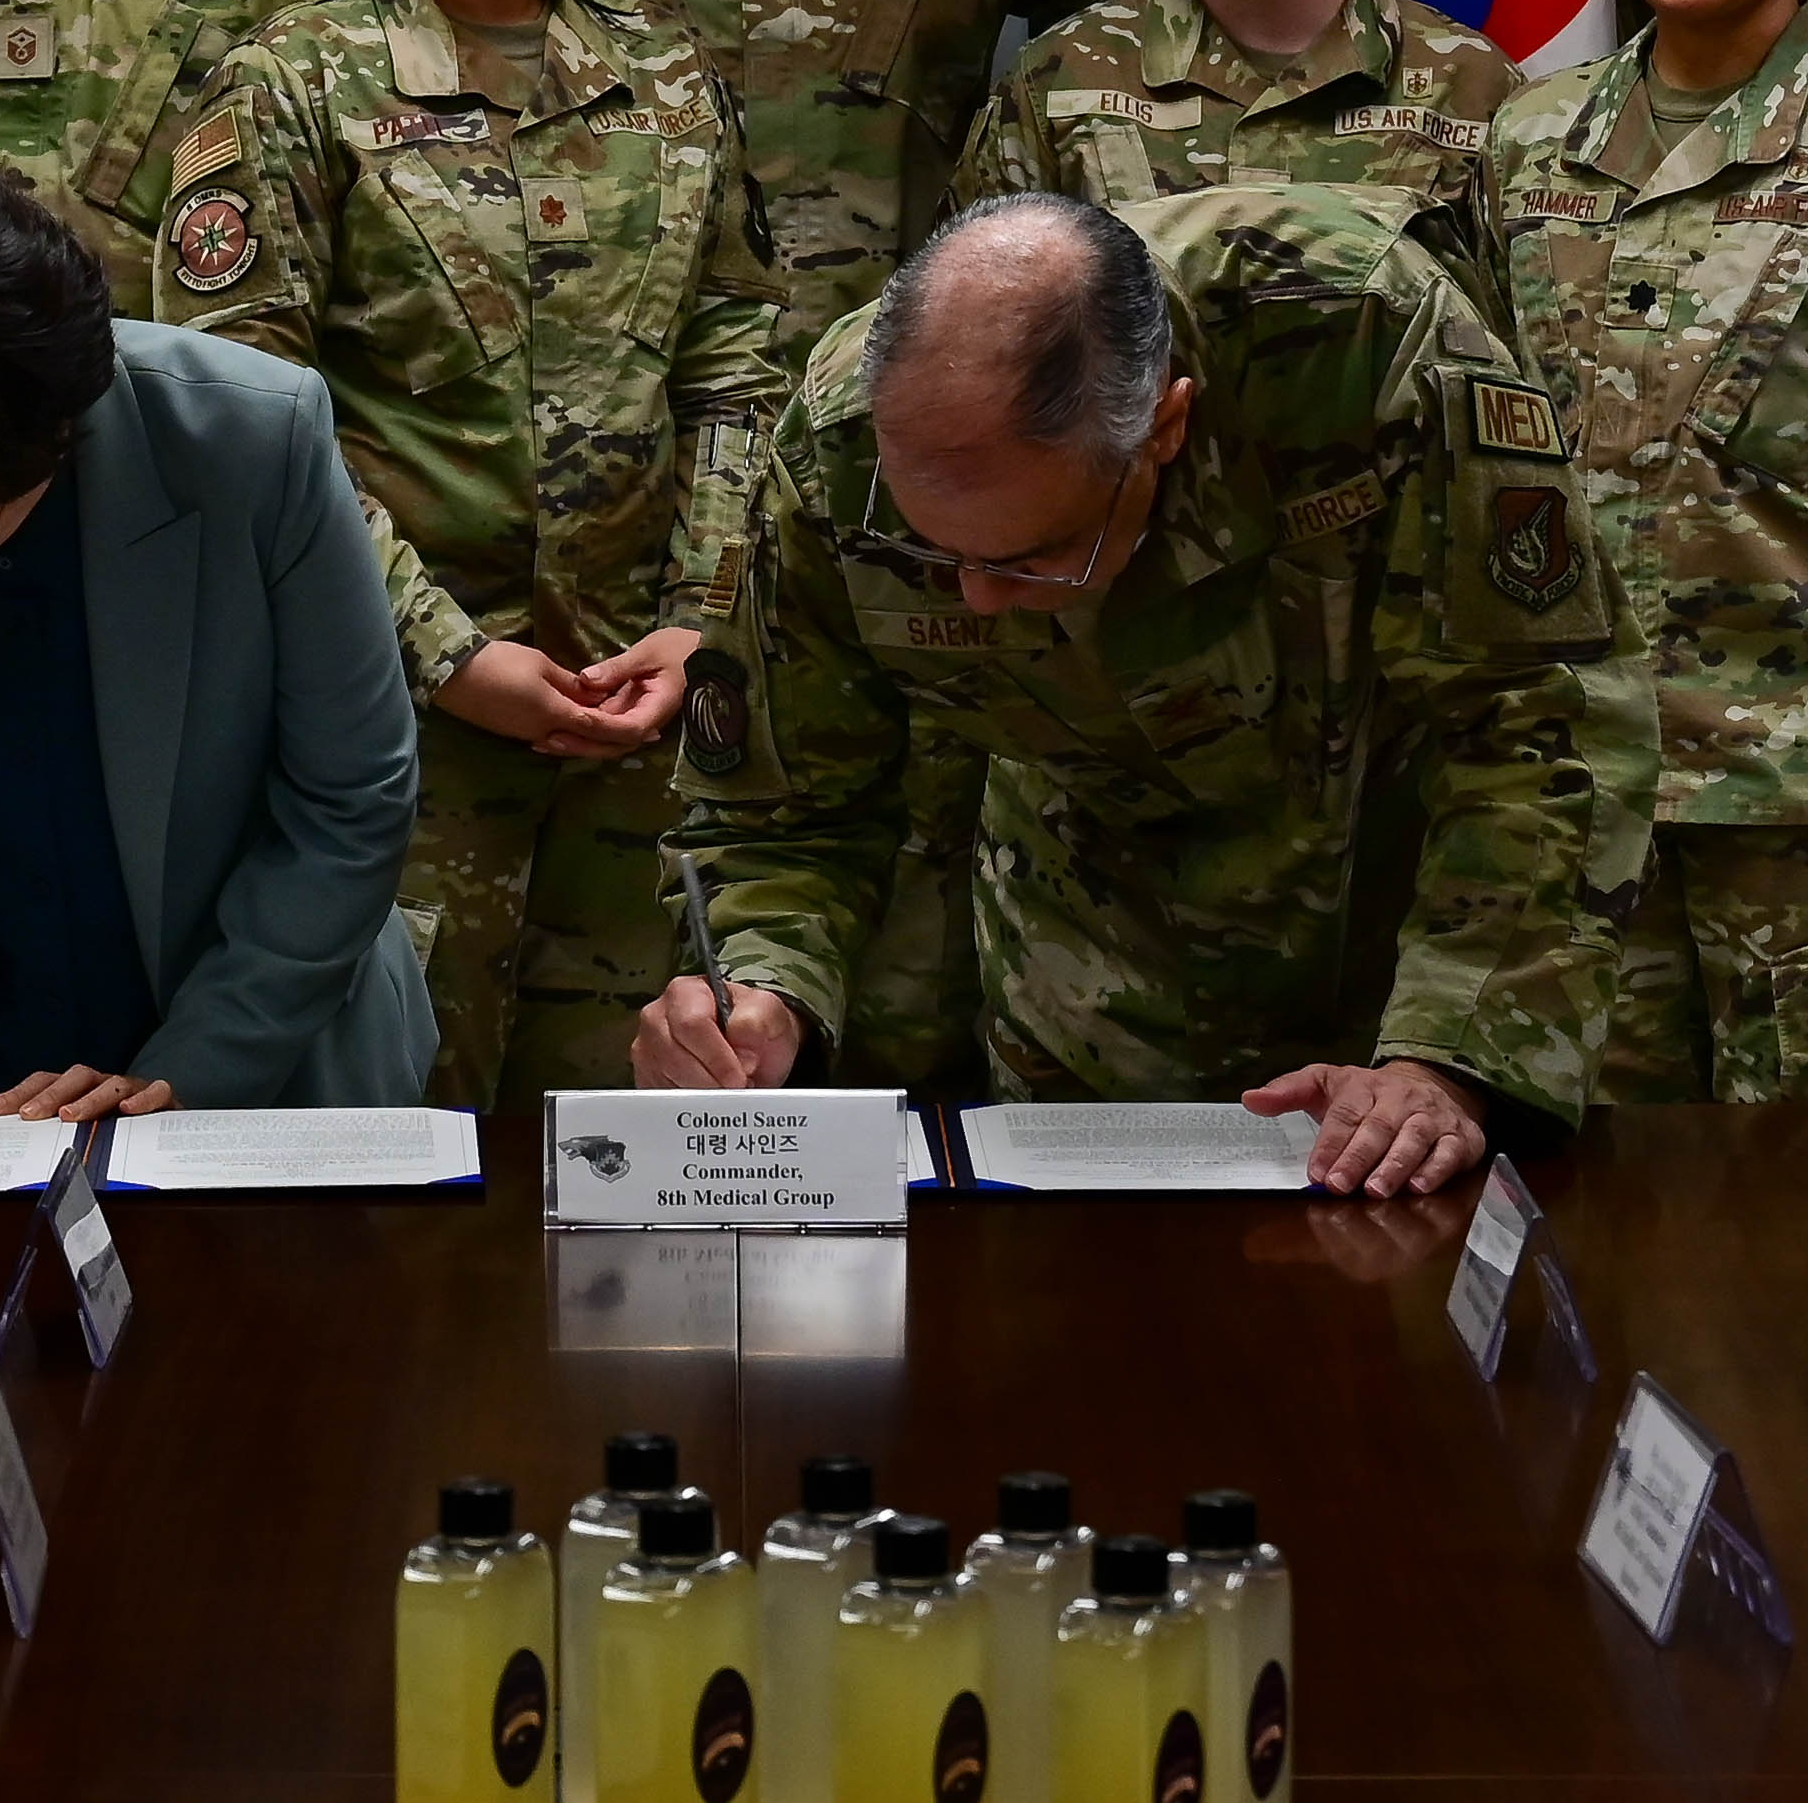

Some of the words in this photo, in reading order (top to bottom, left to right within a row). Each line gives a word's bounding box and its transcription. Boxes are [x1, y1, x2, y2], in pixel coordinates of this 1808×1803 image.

[625, 111, 653, 131] AIR
[1100, 92, 1154, 124] ELLIS
[1340, 110, 1374, 132] U.S.
[1381, 108, 1417, 130] AIR
[1421, 110, 1480, 148] FORCE
[1523, 191, 1597, 220] HAMMER
[229, 243, 256, 280] TONIGHT
[1480, 385, 1551, 450] MED
[1293, 480, 1378, 538] FORCE
[906, 615, 1002, 647] SAENZ
[676, 1111, 747, 1130] Colonel
[753, 1111, 808, 1129] Saenz
[686, 1133, 728, 1157] 대령
[735, 1133, 800, 1157] 사인즈
[682, 1163, 804, 1183] Commander,
[657, 1189, 687, 1207] 8th
[693, 1189, 768, 1207] Medical
[773, 1189, 835, 1210] Group
